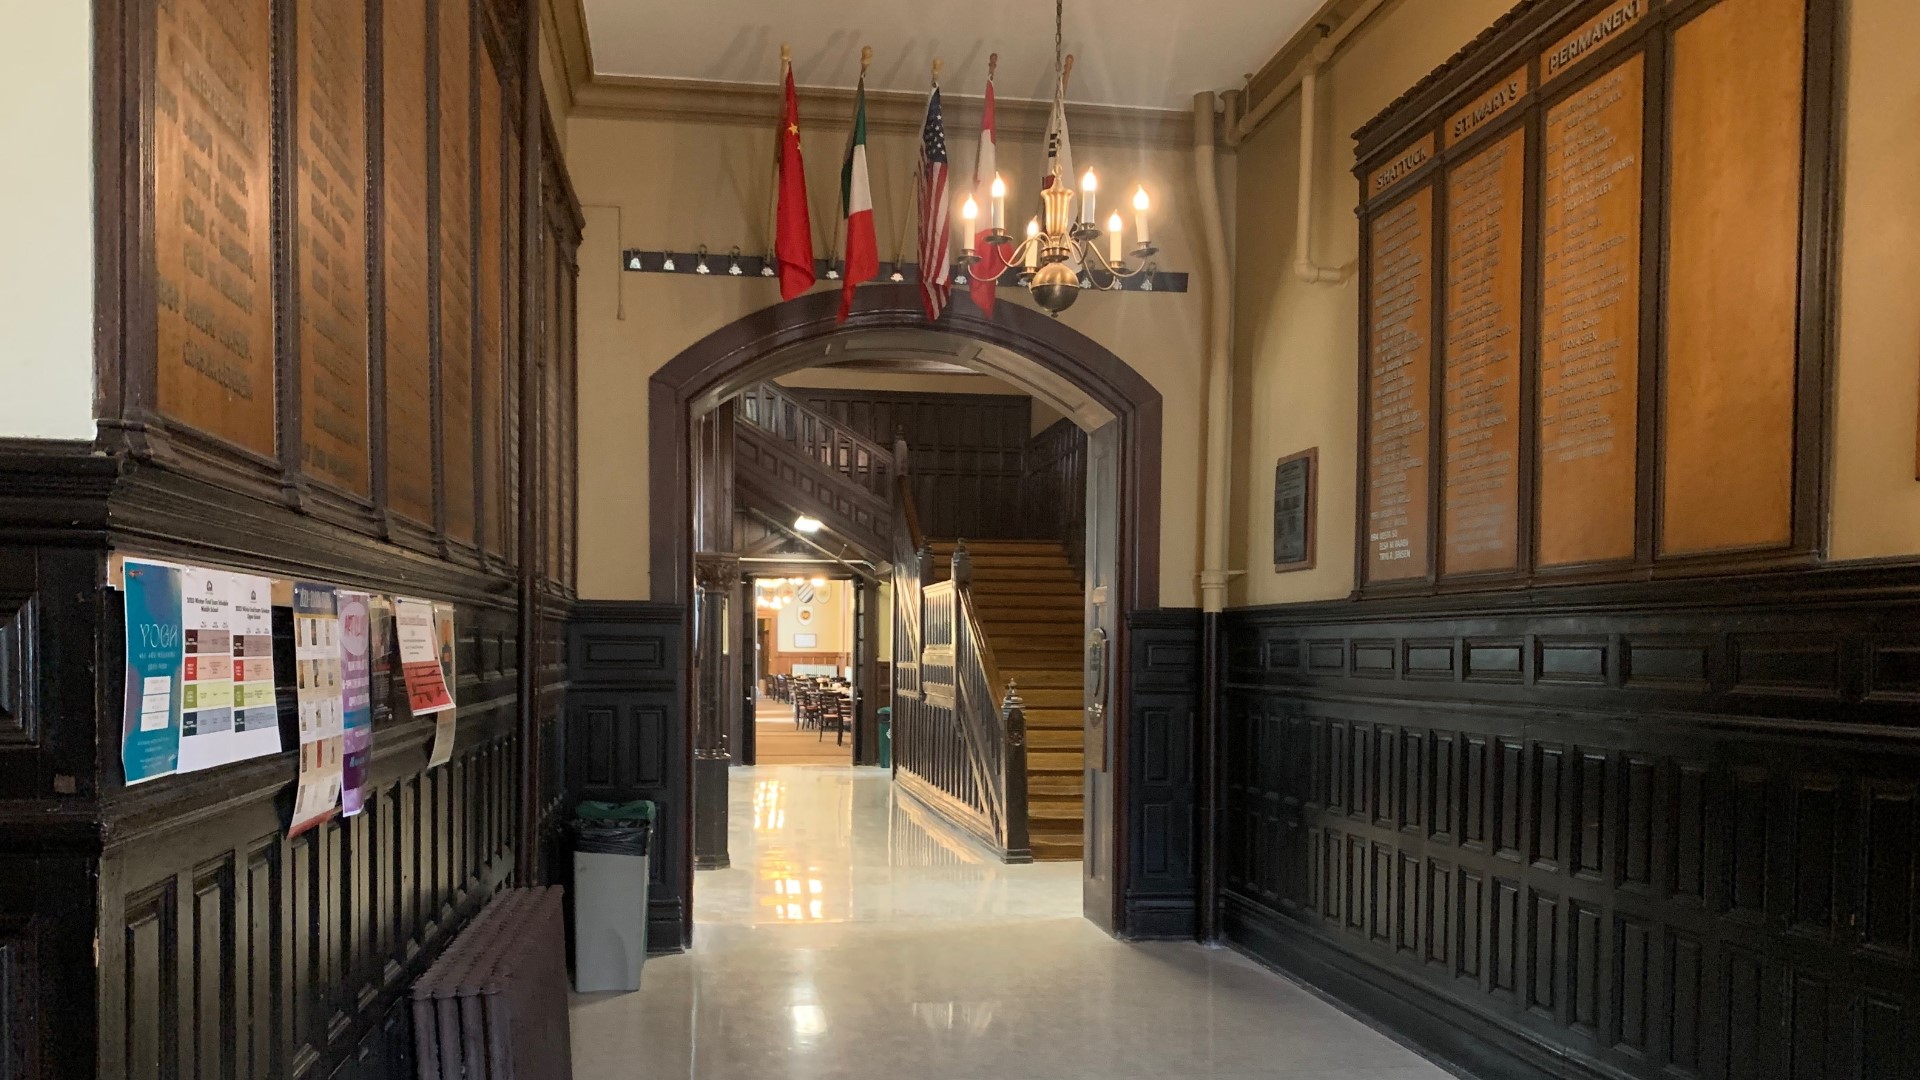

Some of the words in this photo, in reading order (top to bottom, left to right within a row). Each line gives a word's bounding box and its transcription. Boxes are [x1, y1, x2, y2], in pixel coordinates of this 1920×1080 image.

[1548, 0, 1641, 74] PERMANENT
[1454, 117, 1471, 138] ST.
[1471, 81, 1519, 126] MARY'S
[1376, 147, 1427, 190] SHATTUCK
[140, 623, 178, 648] YOGA
